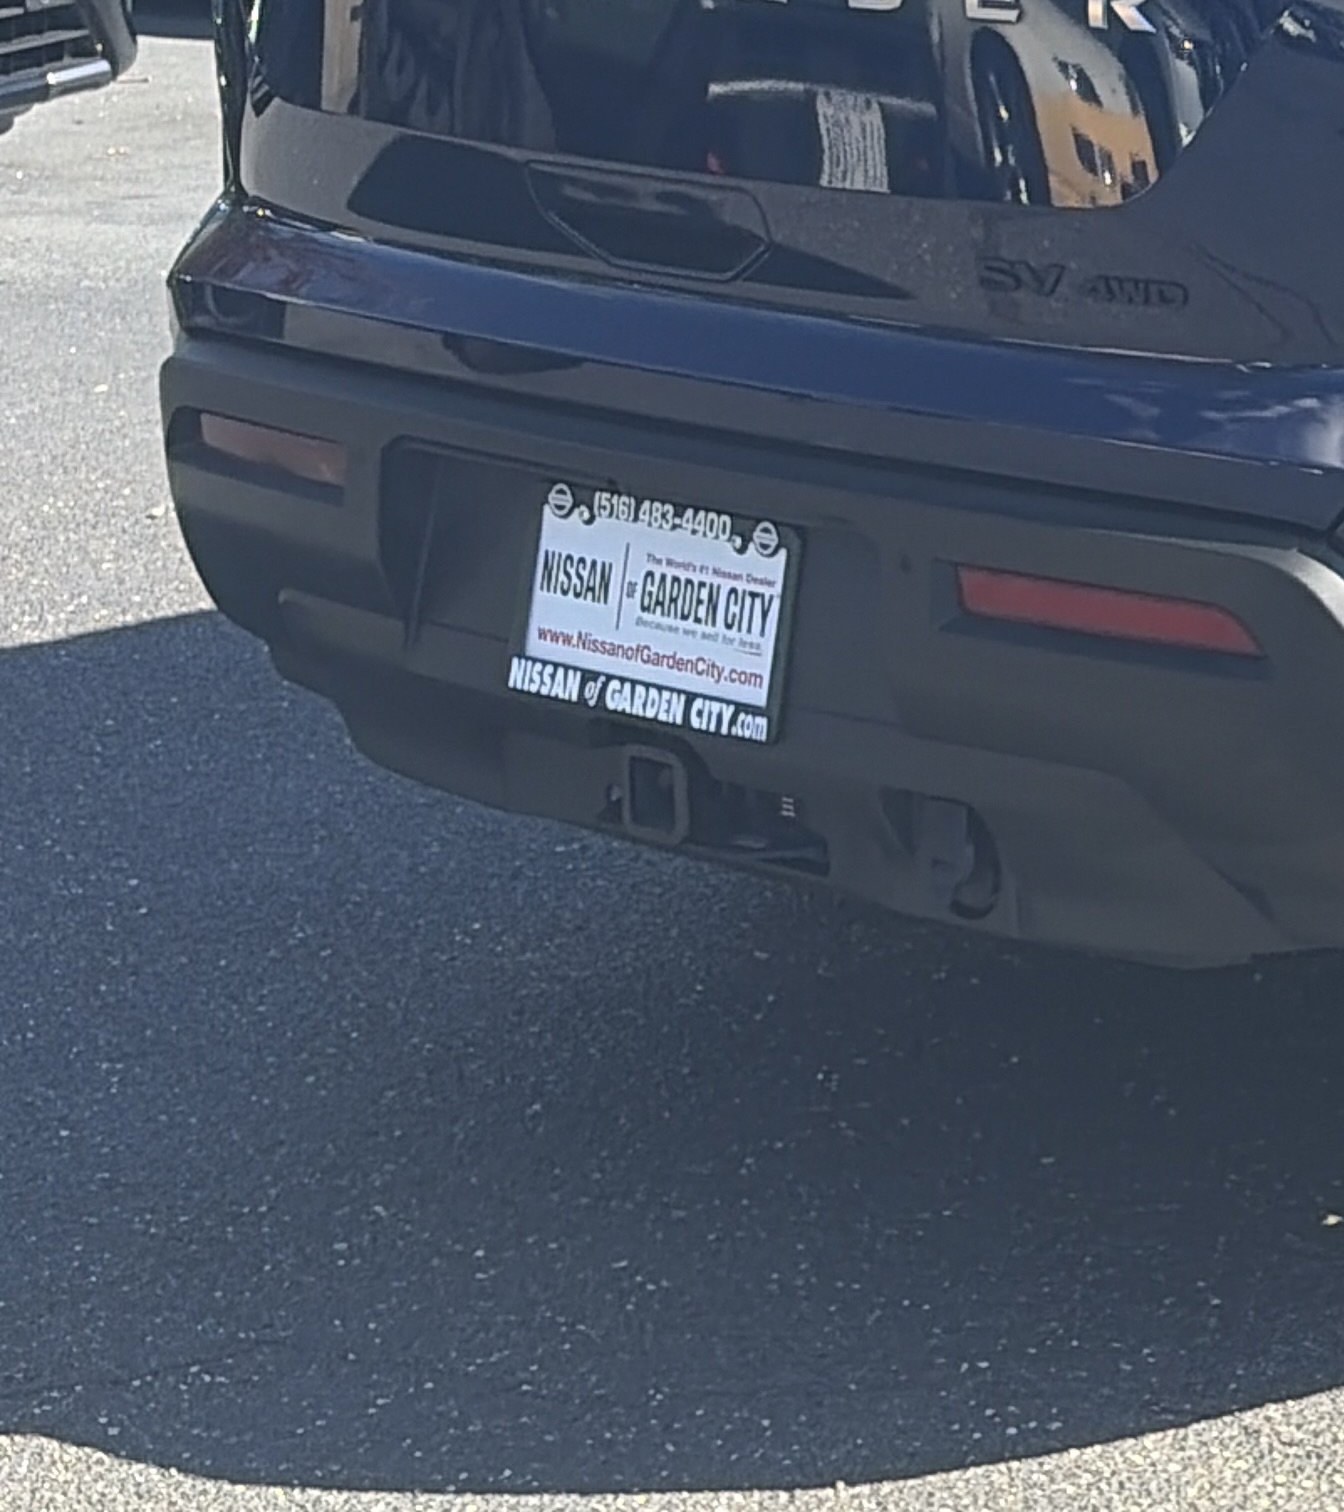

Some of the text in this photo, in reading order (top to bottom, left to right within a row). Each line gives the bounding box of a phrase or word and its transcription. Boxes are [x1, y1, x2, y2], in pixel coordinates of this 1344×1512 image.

[975, 257, 1066, 298] SV
[593, 491, 636, 522] (516)
[638, 500, 732, 539] 483-4400
[540, 549, 613, 605] NISSAN
[640, 570, 721, 628] GARDEN
[724, 587, 774, 638] CITY
[537, 625, 764, 689] www.NissanofGardenCity.com
[508, 656, 769, 742] NISSAN of GARDEN CITY.com
